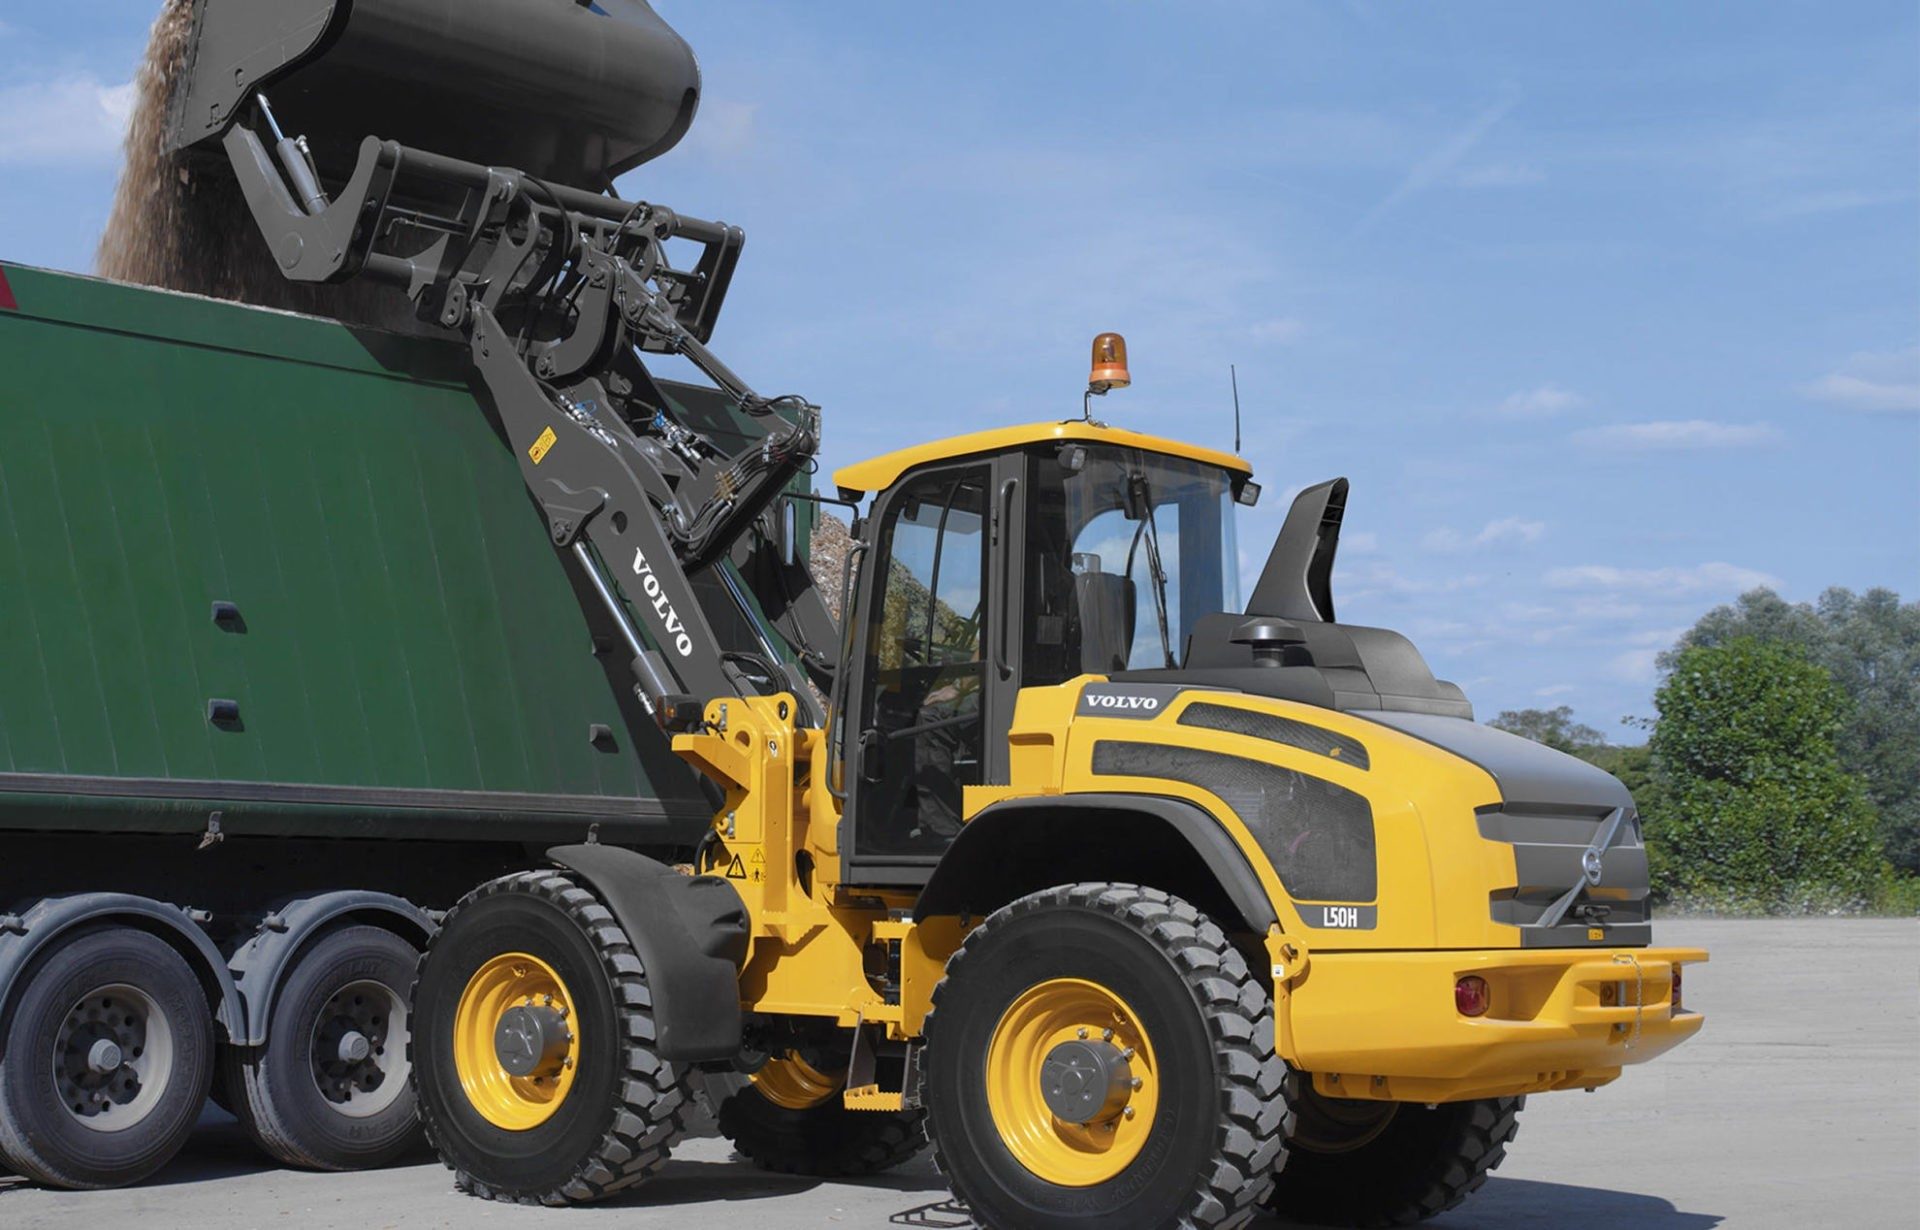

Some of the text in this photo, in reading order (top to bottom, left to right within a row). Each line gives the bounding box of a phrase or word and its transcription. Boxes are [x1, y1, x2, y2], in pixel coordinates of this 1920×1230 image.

[632, 547, 693, 657] VOLVO
[1086, 694, 1158, 710] VOLVO
[1323, 907, 1358, 928] L50H
